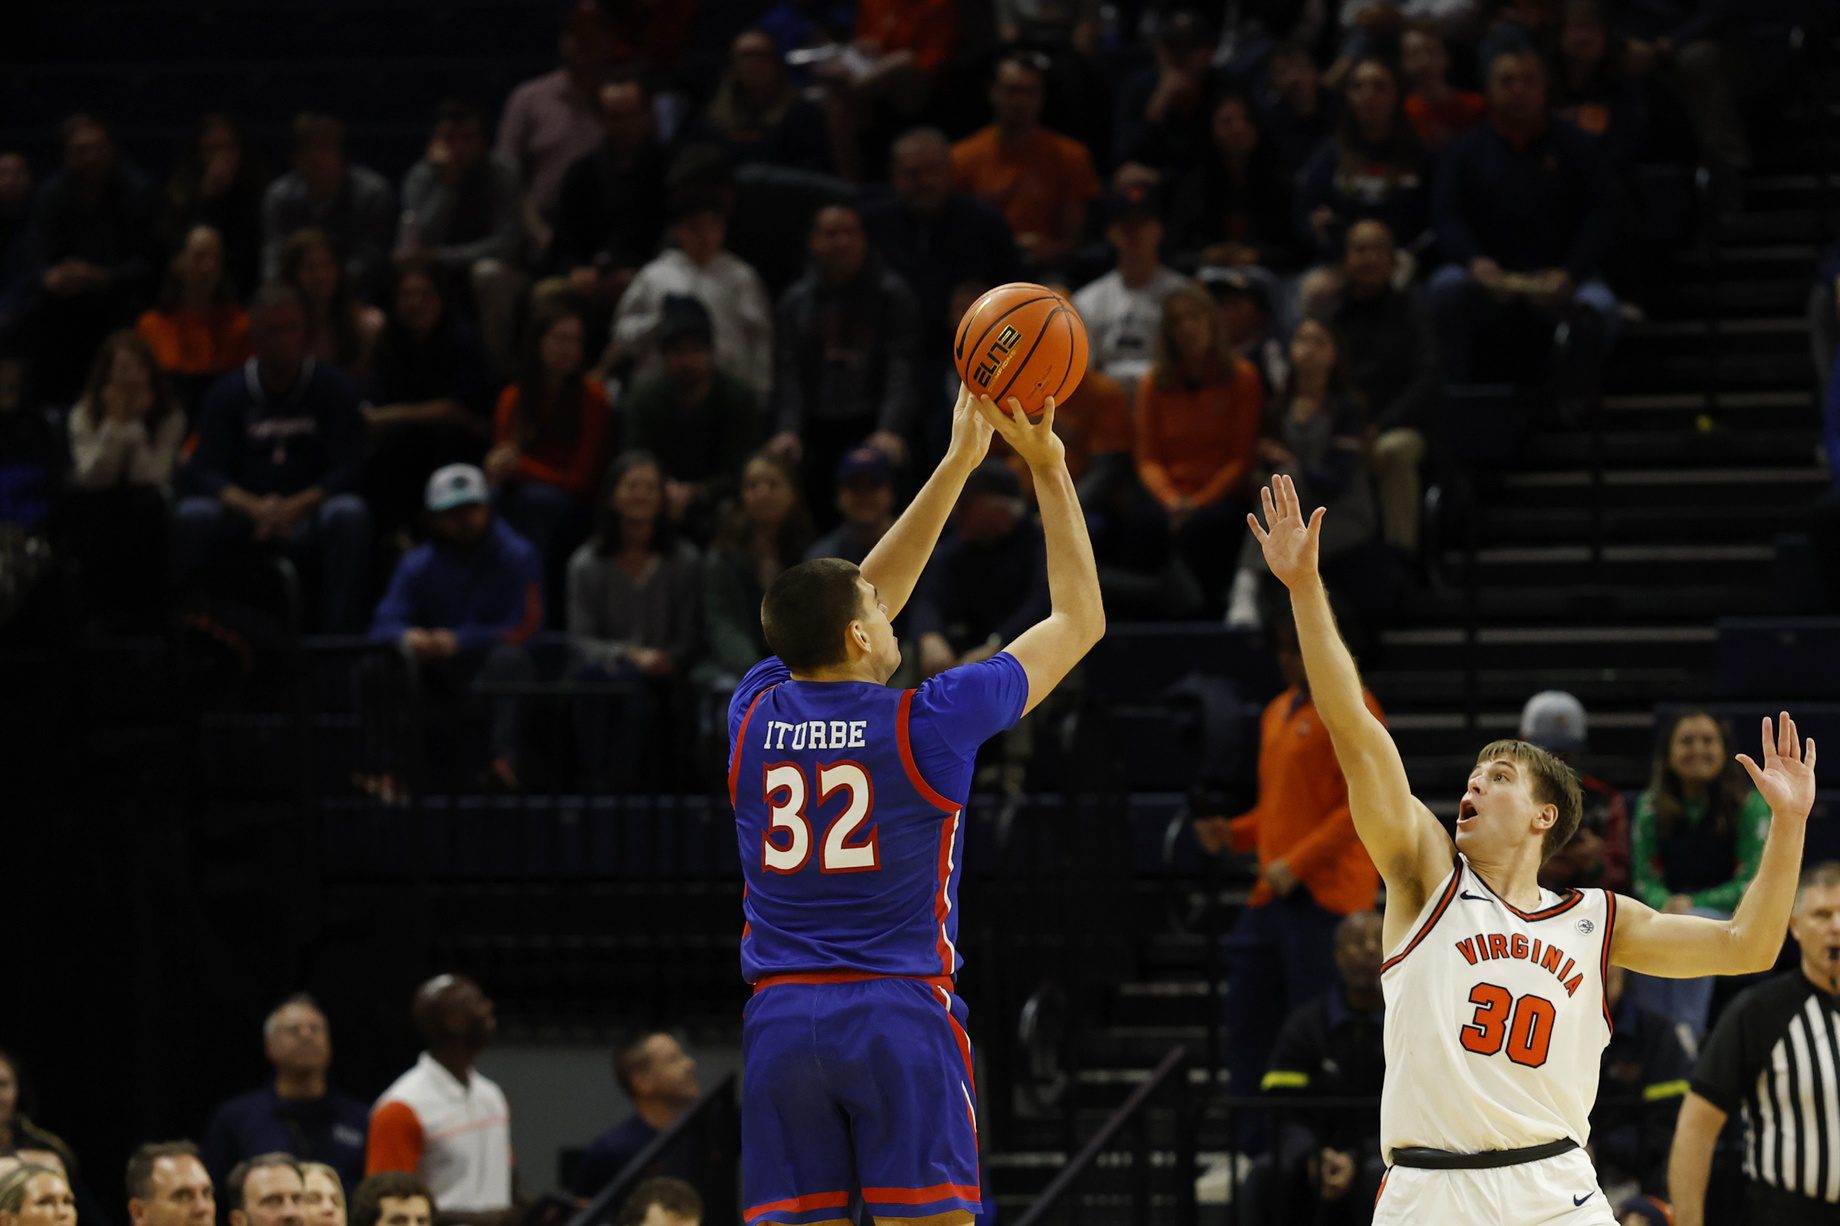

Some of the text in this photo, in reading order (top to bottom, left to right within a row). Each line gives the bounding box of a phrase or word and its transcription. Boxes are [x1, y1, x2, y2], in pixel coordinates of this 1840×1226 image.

[973, 323, 1022, 388] ELITE
[763, 720, 867, 750] ITURBE
[762, 759, 881, 875] 32
[1455, 932, 1584, 998] VIRGINIA
[1459, 981, 1557, 1069] 30
